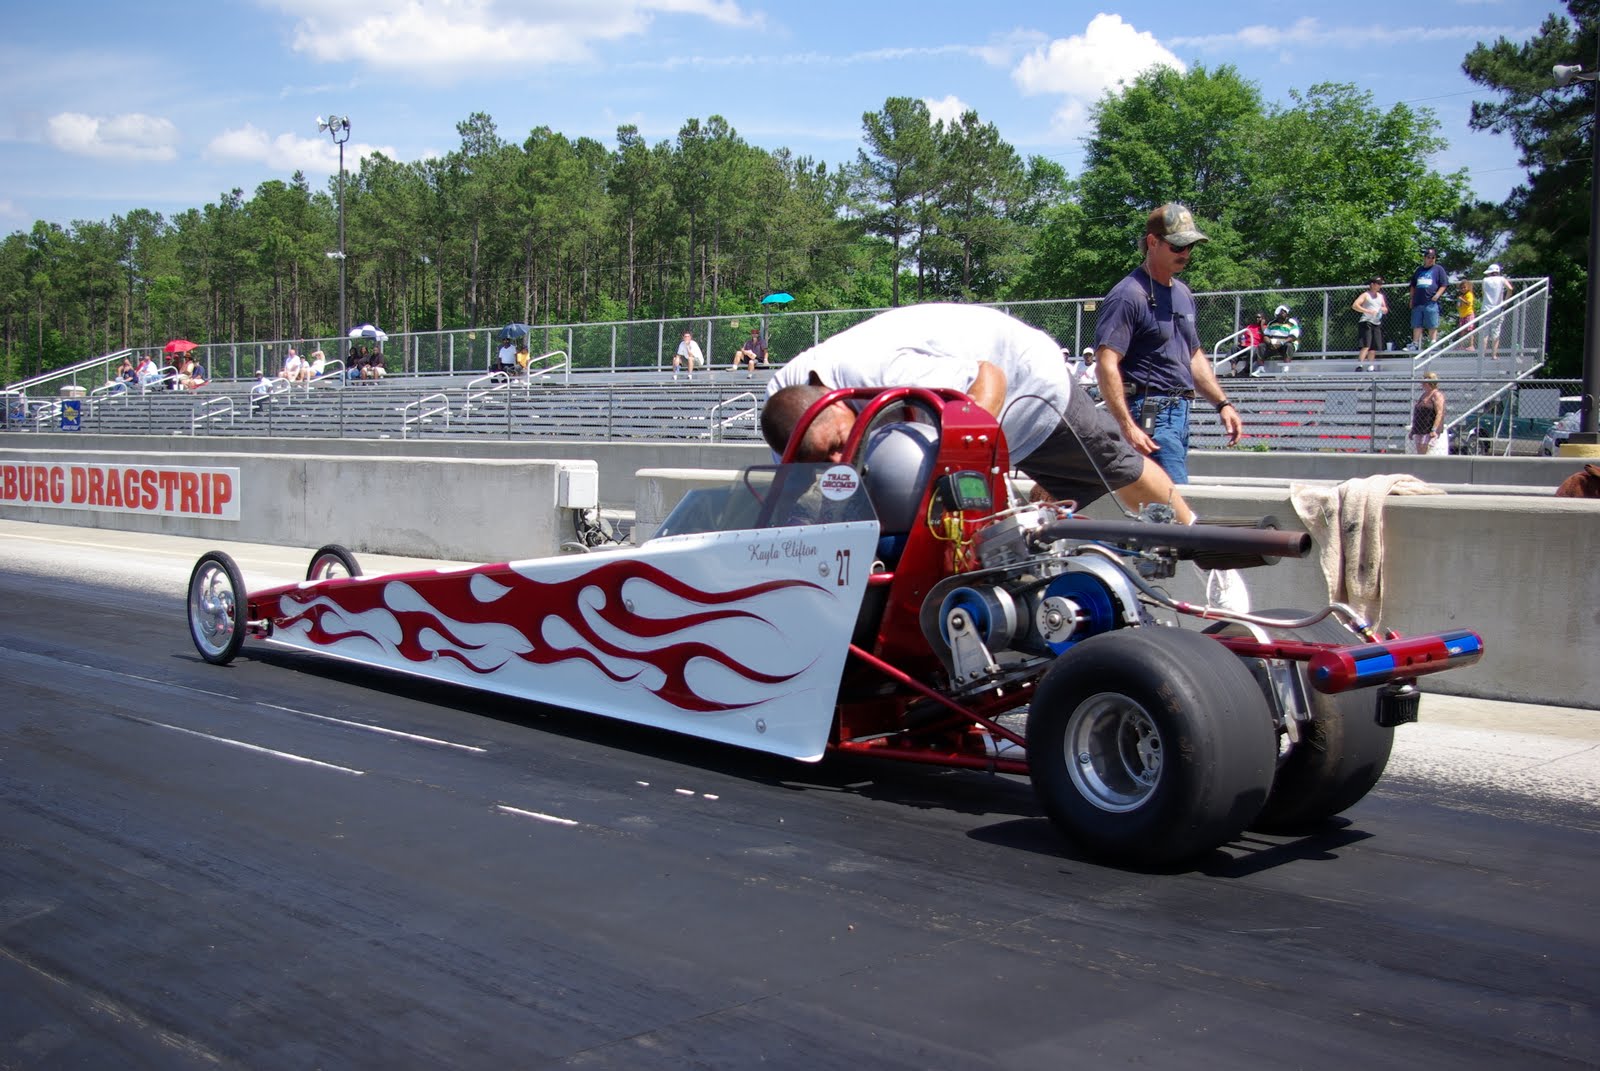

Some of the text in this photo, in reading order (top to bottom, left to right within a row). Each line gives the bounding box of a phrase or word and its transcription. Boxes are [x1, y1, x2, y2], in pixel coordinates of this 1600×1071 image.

[0, 465, 232, 514] BURG DRAGSTRIP
[828, 473, 851, 481] TRACK
[748, 540, 817, 566] Kayla Clifton
[836, 549, 850, 586] 27
